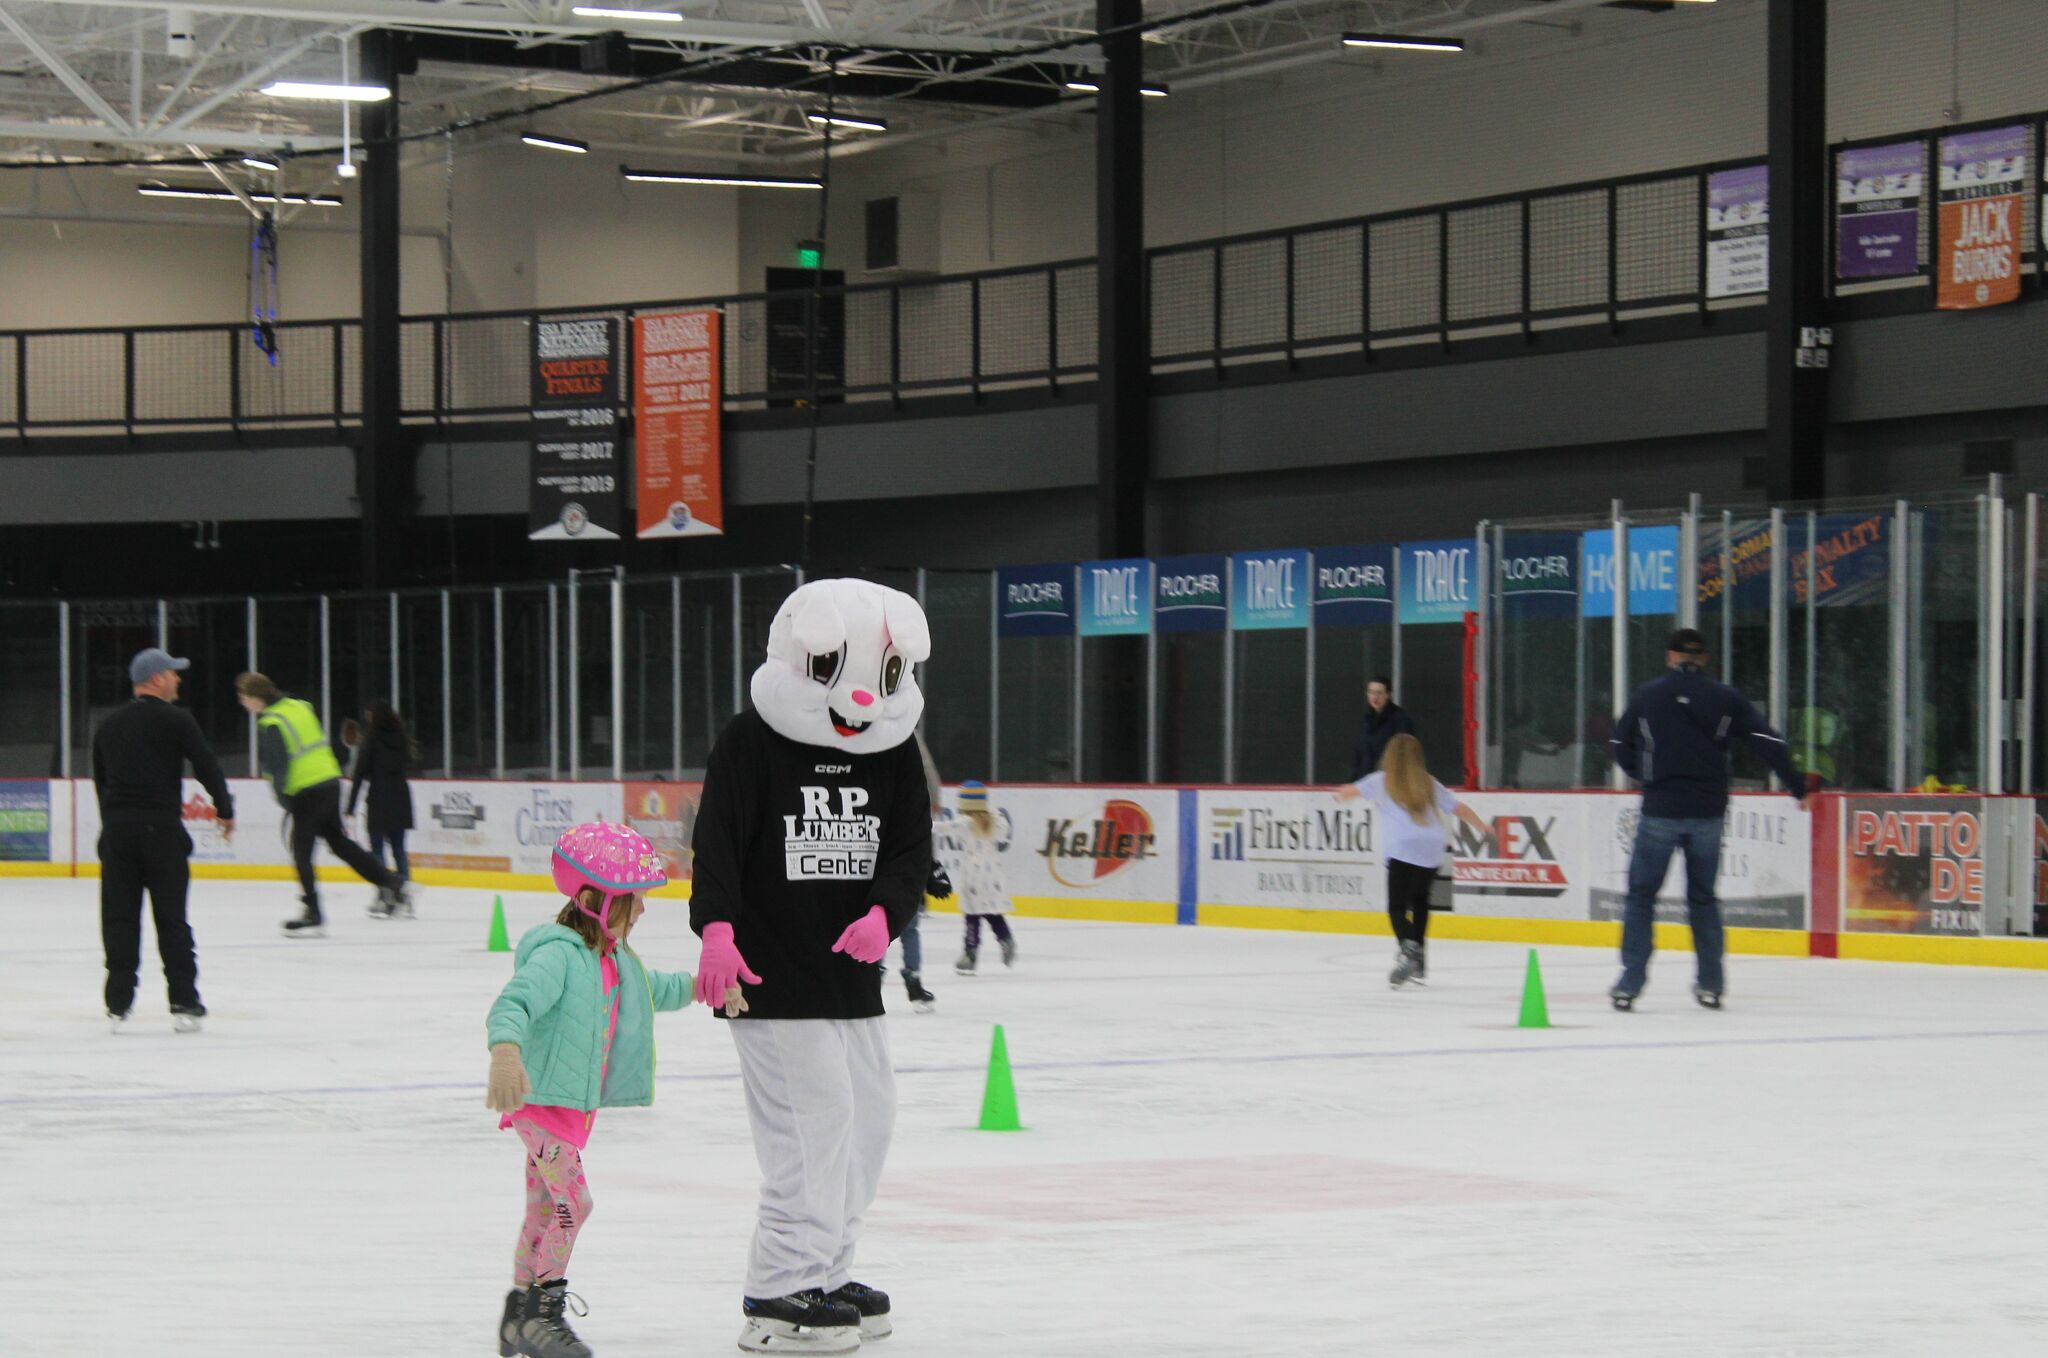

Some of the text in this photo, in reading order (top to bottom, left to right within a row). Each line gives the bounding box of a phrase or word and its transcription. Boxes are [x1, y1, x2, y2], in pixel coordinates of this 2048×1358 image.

[1954, 203, 2012, 247] JACK
[1953, 245, 2012, 283] BURNS
[539, 359, 609, 377] QUARTER
[546, 377, 602, 395] FINALS
[1092, 567, 1139, 616] TRACE
[1160, 574, 1220, 597] PLOCHER
[1245, 558, 1296, 609] TRACE
[1319, 565, 1386, 588] PLOCHER
[1414, 548, 1470, 602] TRACE
[1008, 582, 1063, 603] PLOCHER
[814, 764, 852, 774] CCM
[532, 788, 574, 822] First
[783, 815, 881, 842] LUMBER
[1036, 818, 1158, 860] Keller
[1249, 808, 1374, 852] First Mid
[1853, 810, 1985, 858] PATTO
[1258, 872, 1297, 892] BANK
[1315, 874, 1365, 896] TRUST
